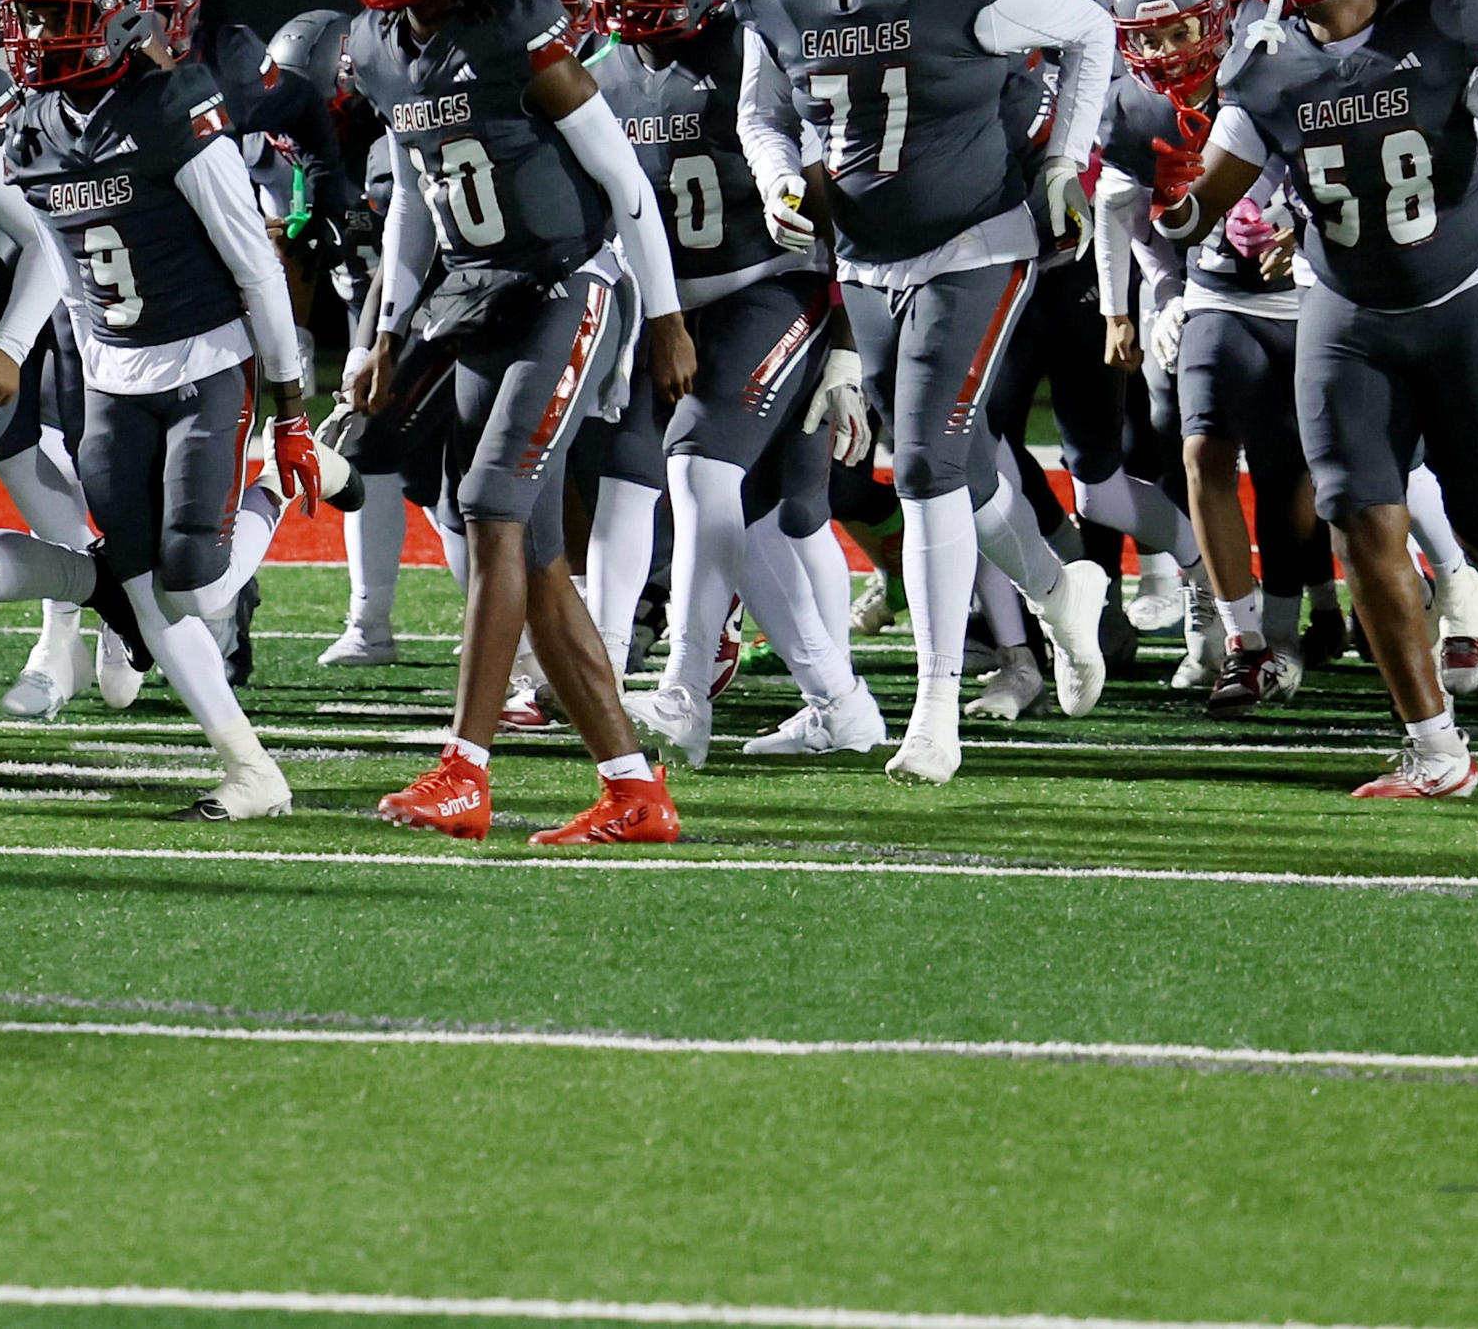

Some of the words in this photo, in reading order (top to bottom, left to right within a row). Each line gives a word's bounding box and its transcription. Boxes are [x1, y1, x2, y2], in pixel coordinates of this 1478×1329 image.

[801, 19, 911, 60] EAGLES
[393, 93, 472, 134] EAGLES
[807, 65, 909, 176] 71
[1297, 87, 1410, 133] EAGLES
[49, 174, 135, 213] EAGLES
[1304, 129, 1439, 248] 58
[81, 224, 144, 327] 9
